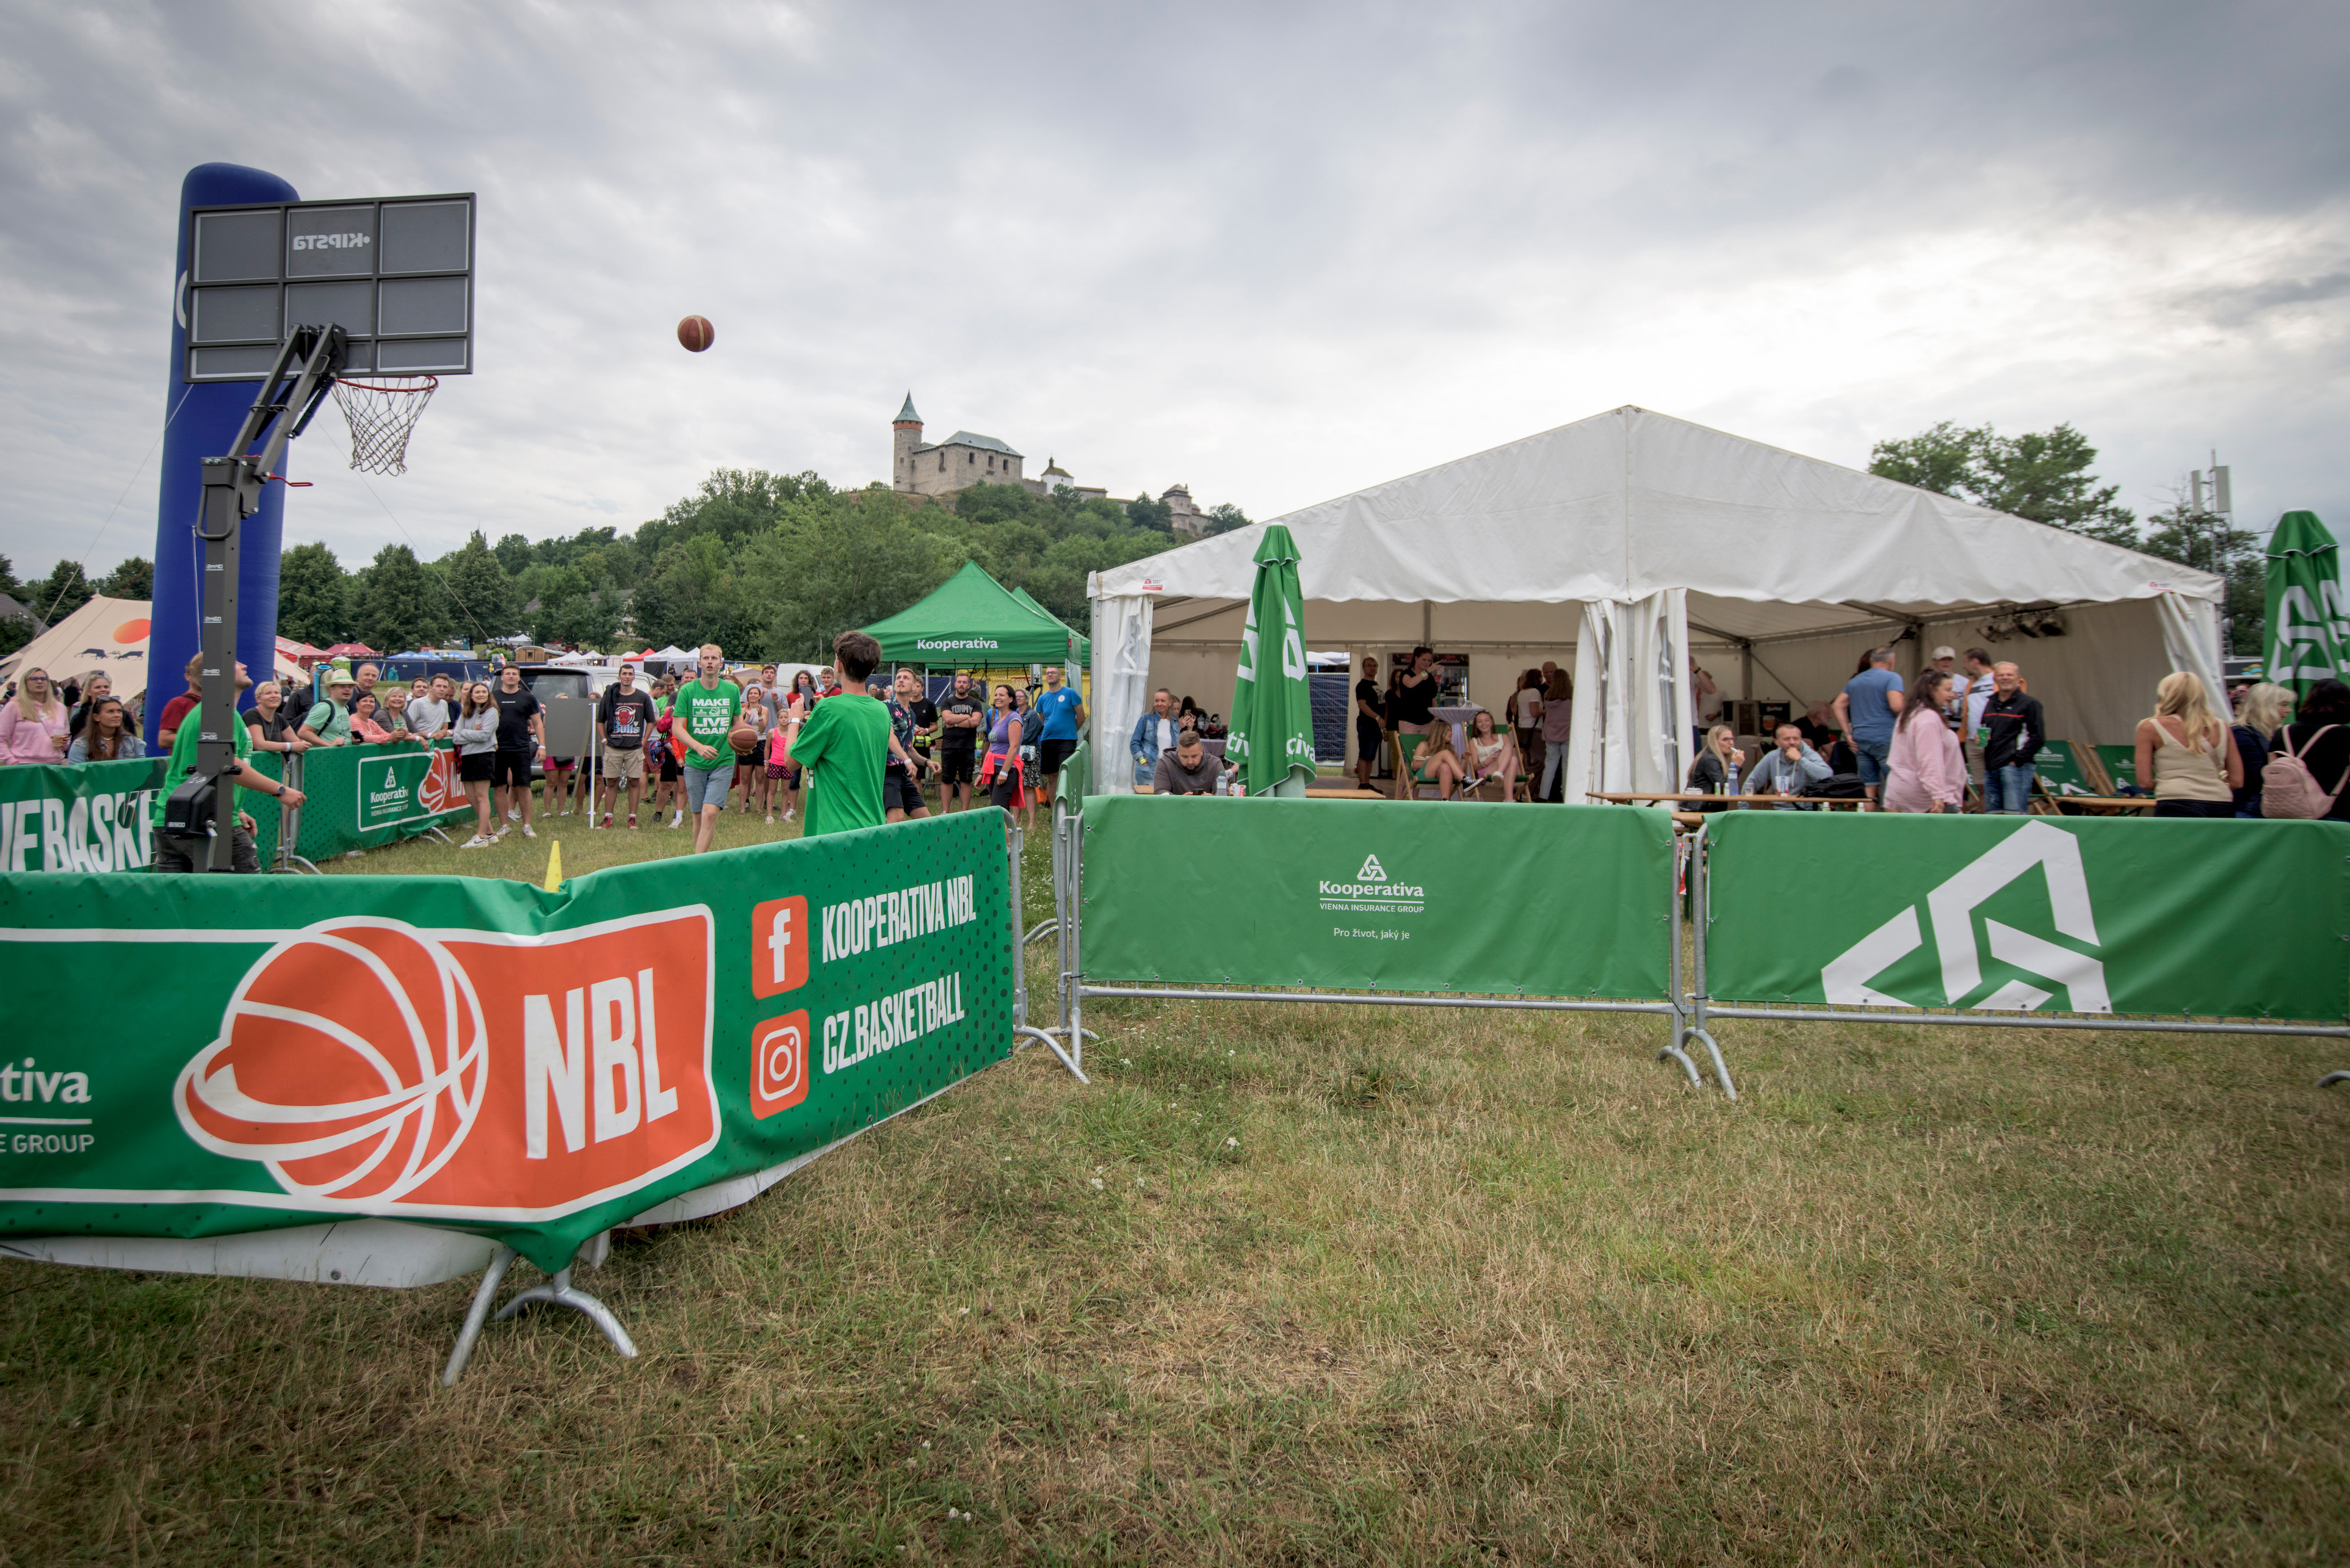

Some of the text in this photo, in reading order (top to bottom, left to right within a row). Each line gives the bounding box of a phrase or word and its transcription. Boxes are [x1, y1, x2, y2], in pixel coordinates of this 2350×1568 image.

[917, 637, 999, 651] Kooperativa
[693, 698, 730, 707] MAKE
[951, 705, 974, 715] TOMMY
[612, 721, 640, 734] Bulls
[693, 718, 730, 727] LIVE
[371, 786, 409, 803] Kooperativ
[1320, 881, 1424, 898] Kooperativa
[1351, 904, 1396, 912] INSURANCE
[822, 874, 976, 963] KOOPERATIVA NBL
[1334, 928, 1410, 940] Pro život, jaký je
[822, 971, 964, 1074] CZ.BASKETBALL
[524, 967, 679, 1159] NBL
[12, 1134, 95, 1153] GROUP
